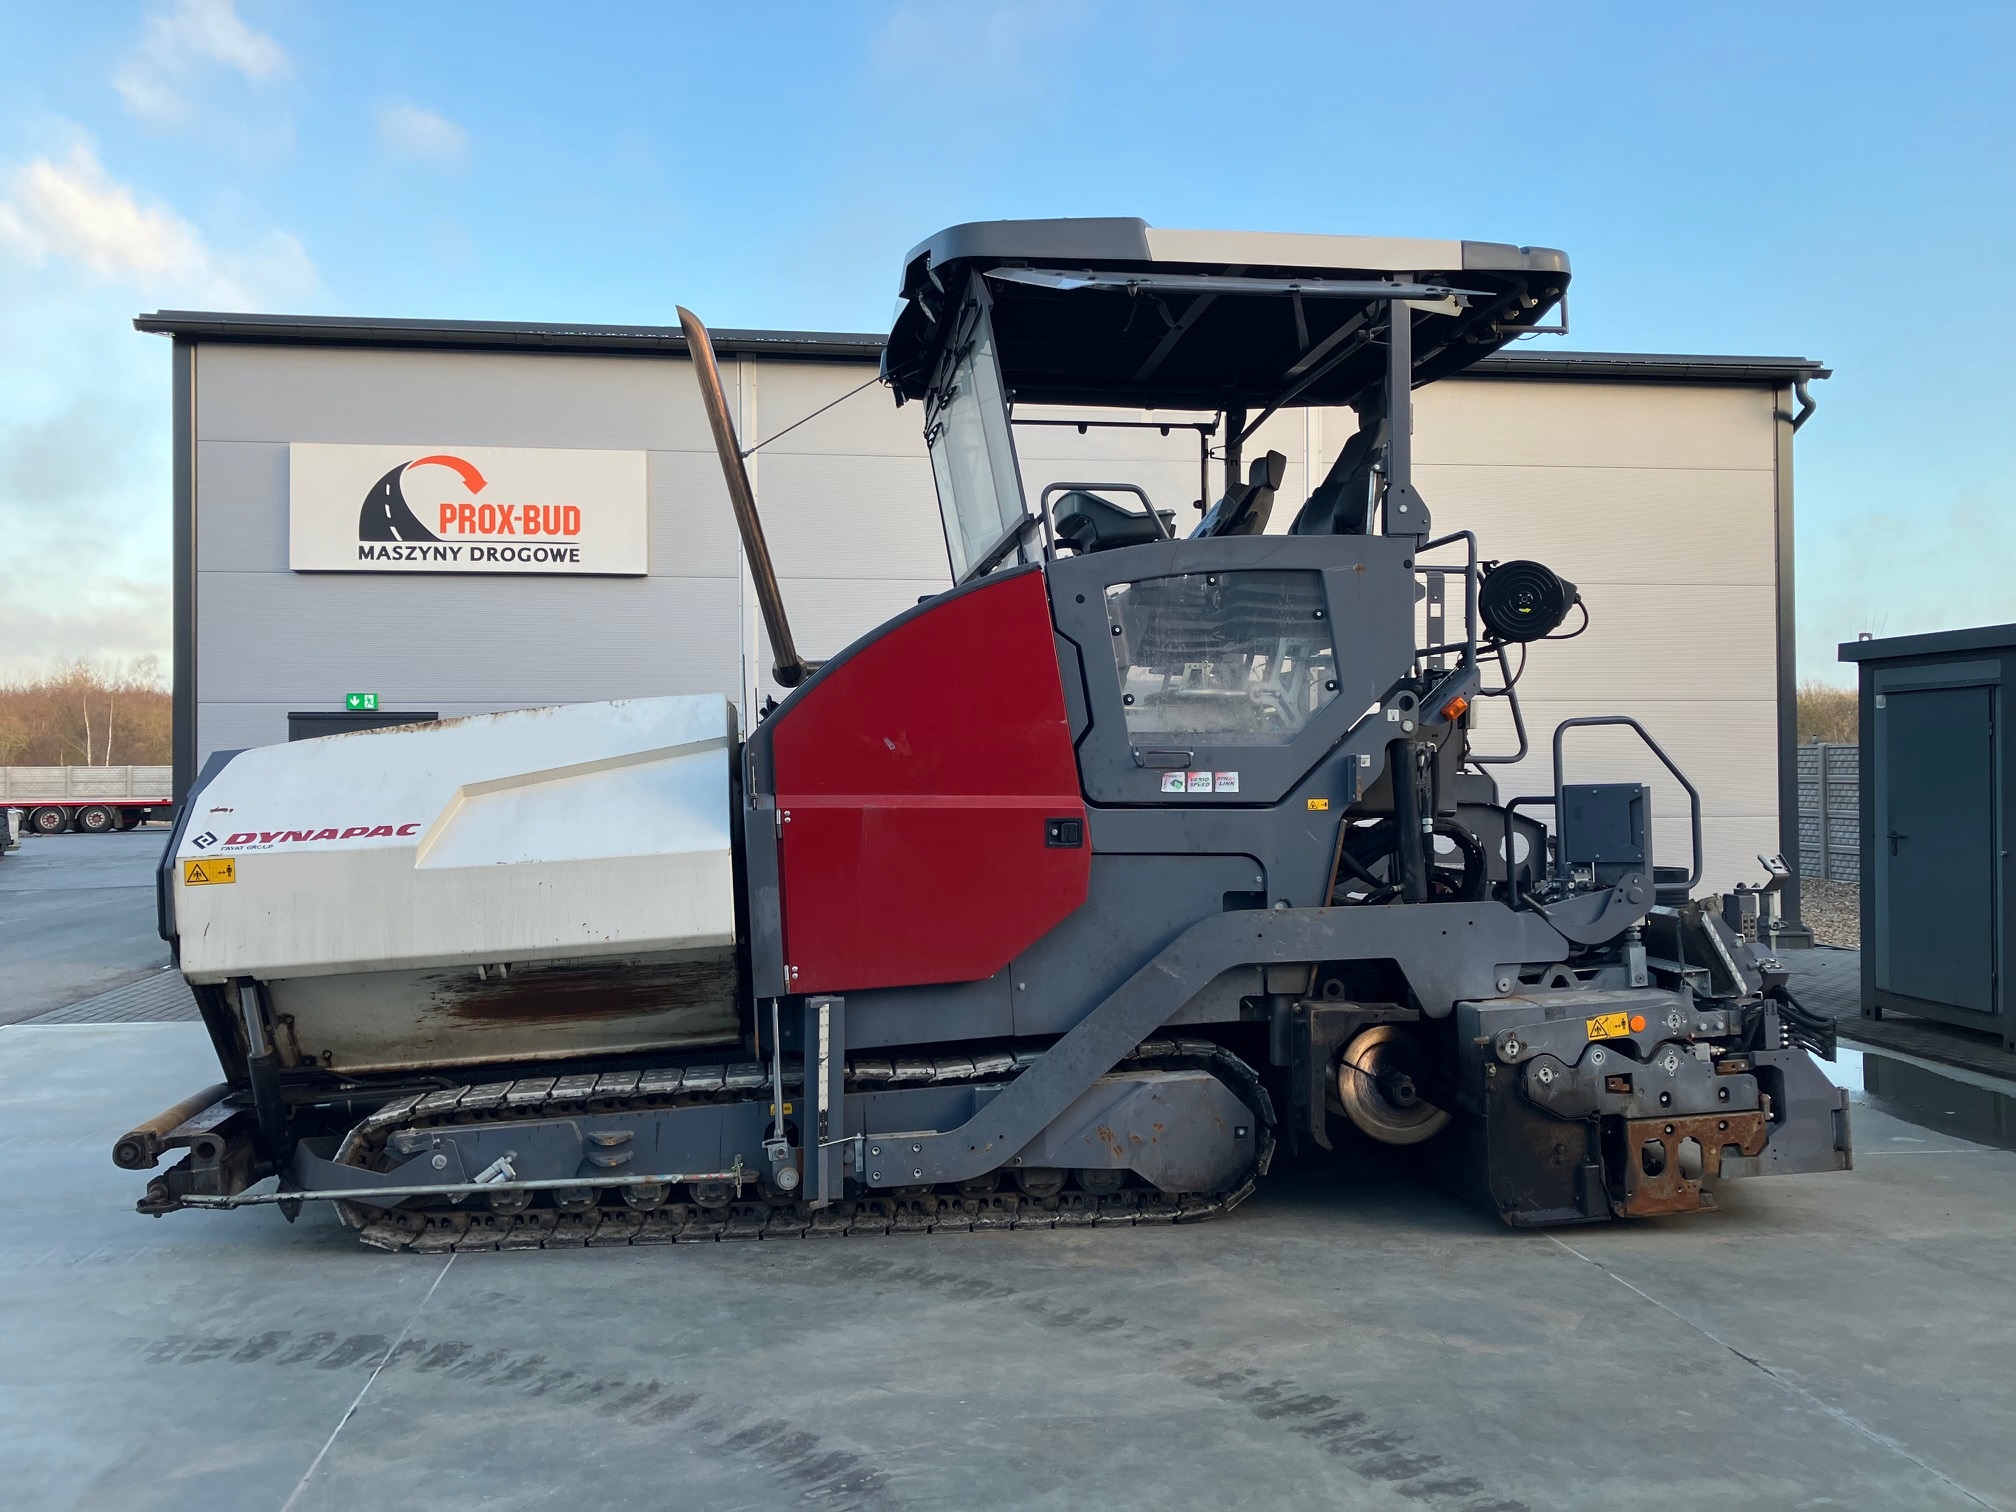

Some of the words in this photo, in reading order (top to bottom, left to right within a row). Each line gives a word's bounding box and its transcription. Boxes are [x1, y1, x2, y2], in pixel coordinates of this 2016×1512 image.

[439, 503, 581, 536] PROX-BUD
[358, 545, 463, 562] MASZYNY
[470, 546, 581, 563] DROGOWE
[223, 823, 422, 846] DYNAPAC
